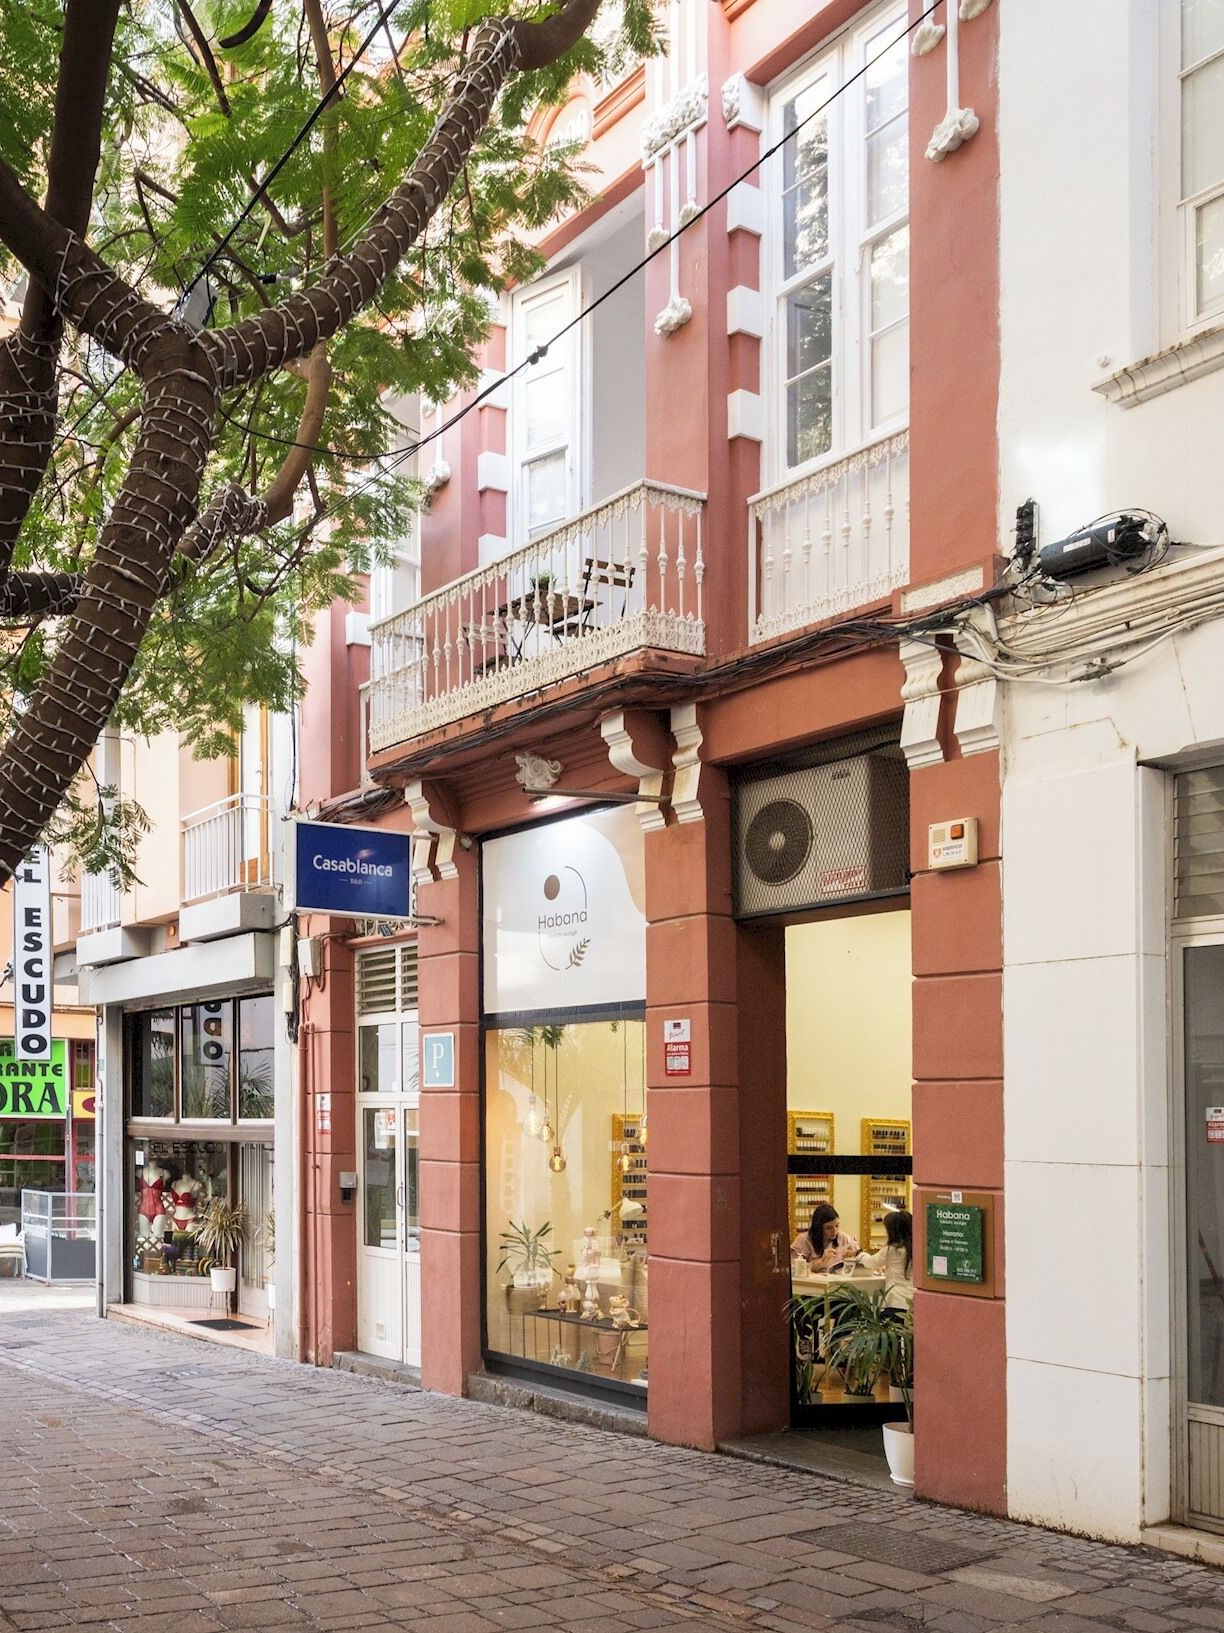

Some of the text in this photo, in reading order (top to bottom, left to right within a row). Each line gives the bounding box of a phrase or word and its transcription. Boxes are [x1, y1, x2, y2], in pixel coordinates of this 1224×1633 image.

[312, 854, 393, 877] Casablanca
[538, 910, 588, 929] Habana
[21, 850, 48, 1055] EL ESCUDO
[667, 1043, 689, 1052] Alarma
[936, 1209, 971, 1221] Habana
